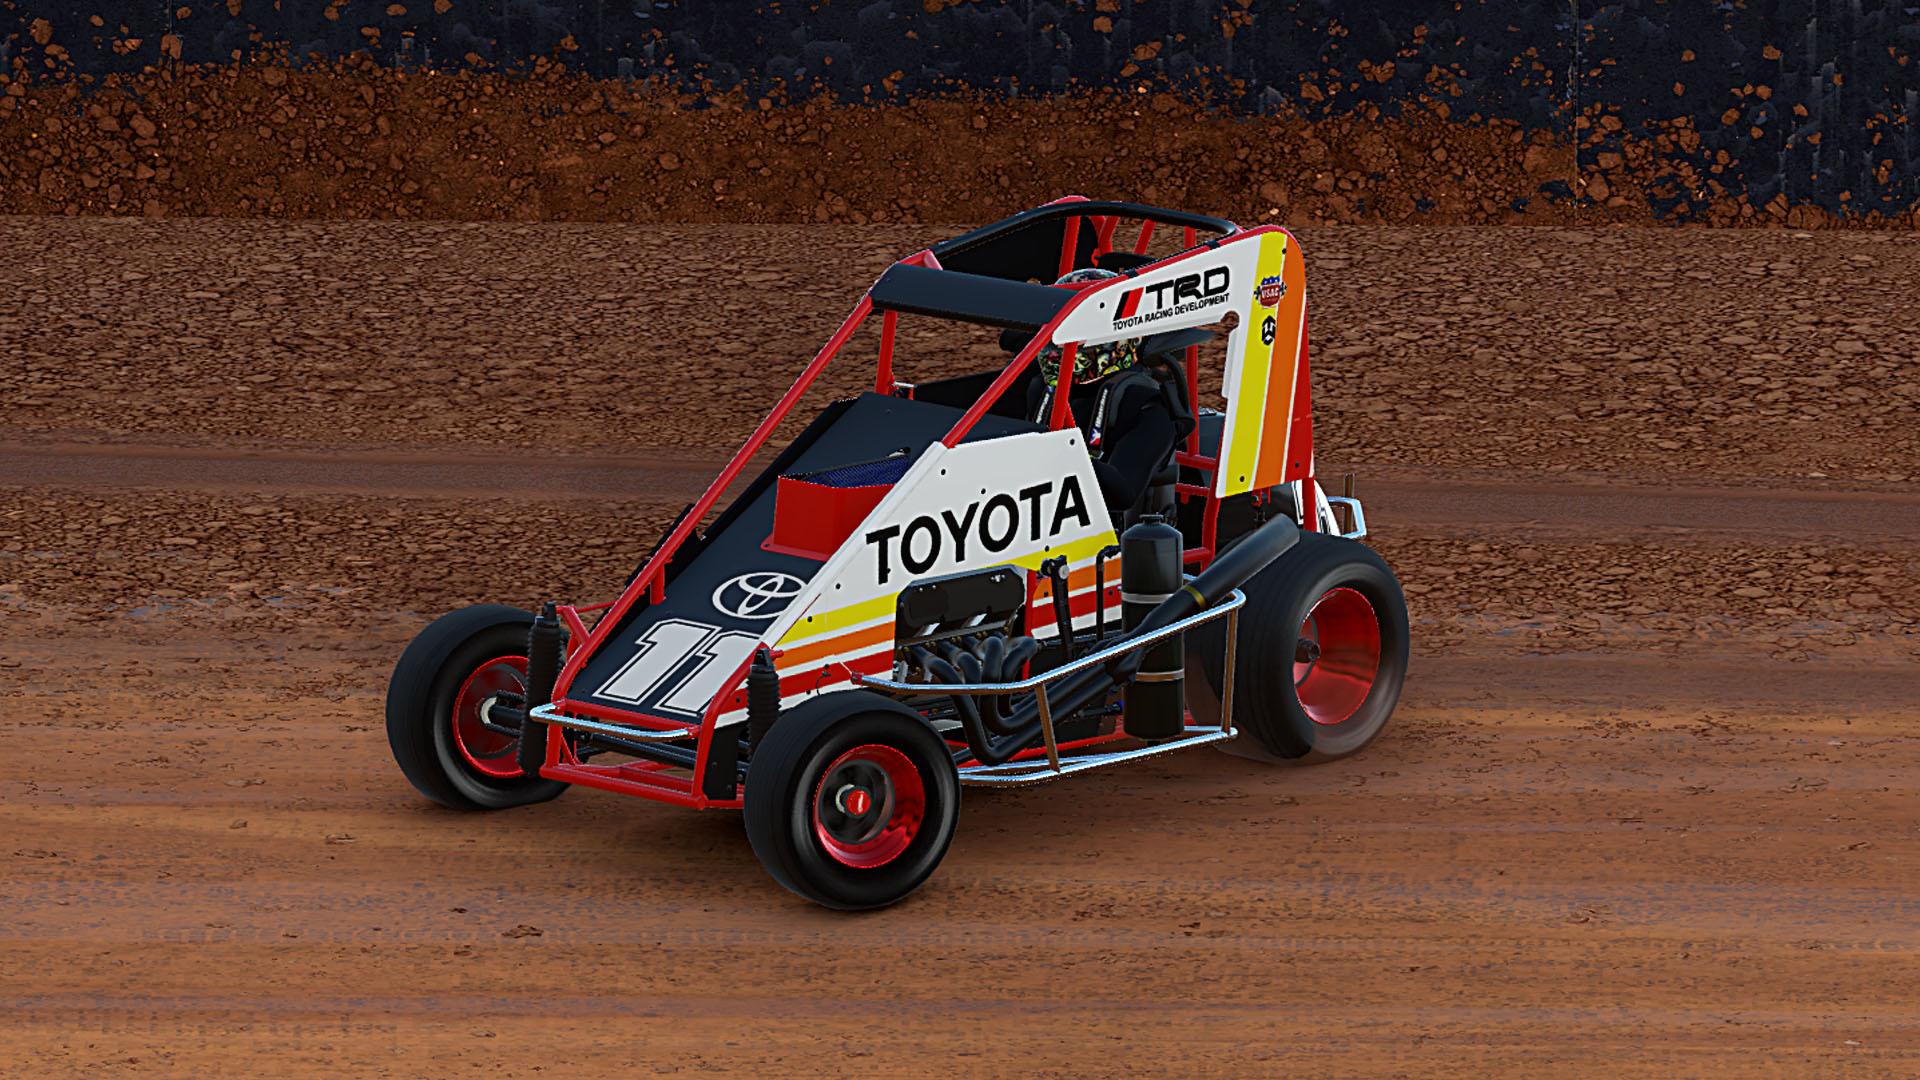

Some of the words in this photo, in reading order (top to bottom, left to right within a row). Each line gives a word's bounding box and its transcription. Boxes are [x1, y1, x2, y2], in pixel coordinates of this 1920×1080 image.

[1112, 315, 1144, 331] TOYOTA
[1144, 307, 1174, 323] RACING
[1174, 292, 1231, 315] DEVELOPMENT
[1145, 265, 1231, 310] TRD
[865, 475, 1092, 585] TOYOTA
[592, 618, 763, 718] 11
